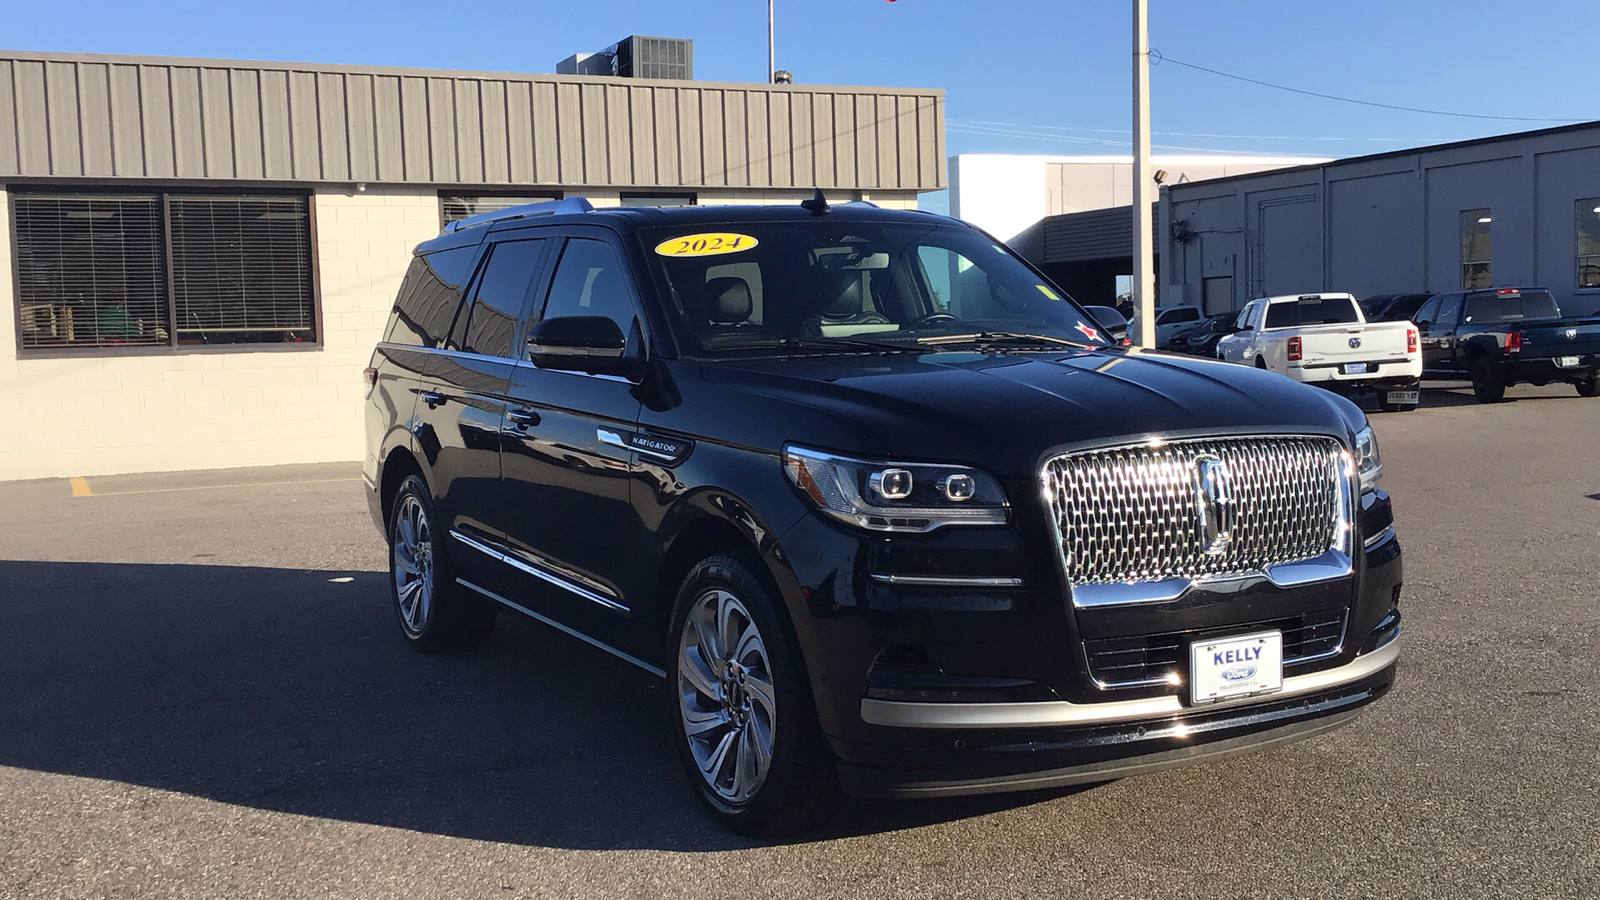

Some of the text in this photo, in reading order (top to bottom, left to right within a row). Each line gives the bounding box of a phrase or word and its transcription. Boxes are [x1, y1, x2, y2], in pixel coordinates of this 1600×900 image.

[674, 236, 742, 254] 2024
[632, 437, 677, 452] NAVIGATOR
[1213, 646, 1263, 666] KELLY
[1226, 666, 1250, 679] Ford
